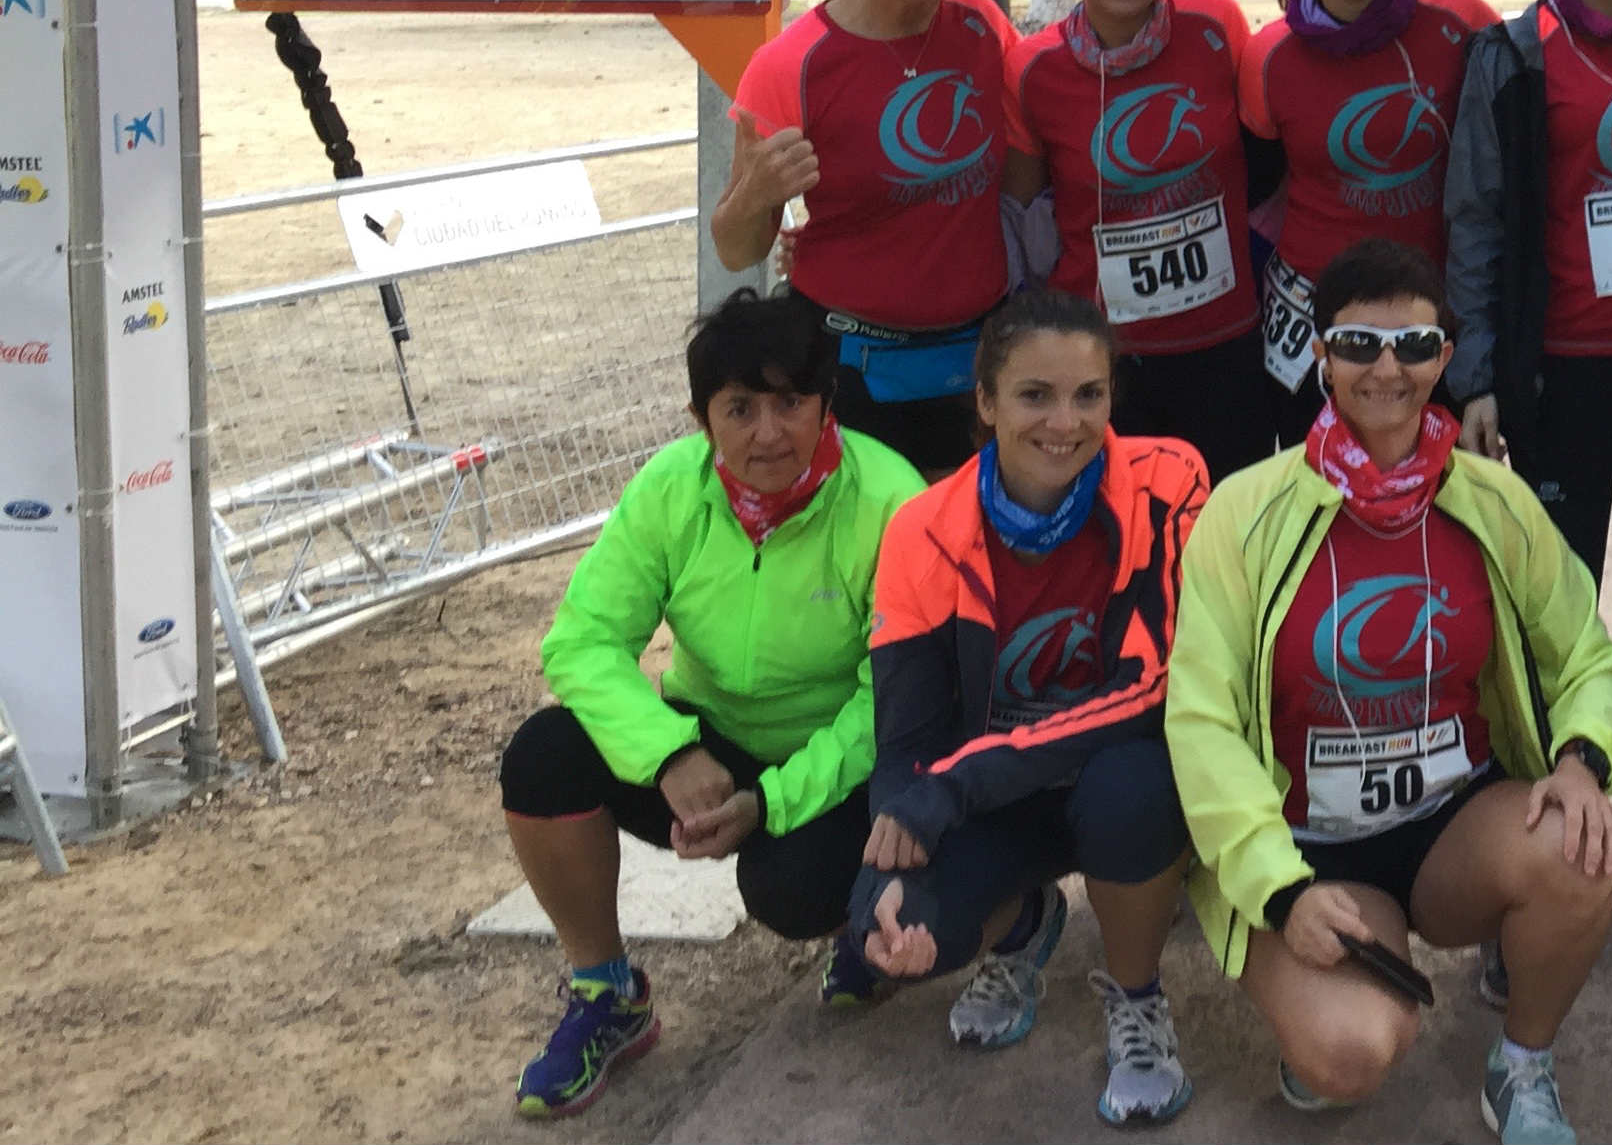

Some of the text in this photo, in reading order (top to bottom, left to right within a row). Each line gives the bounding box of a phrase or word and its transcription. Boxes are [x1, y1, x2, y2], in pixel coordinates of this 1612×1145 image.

[1105, 230, 1160, 247] BREAKFAST
[1129, 241, 1208, 297] 540
[121, 282, 163, 304] AMSTEL
[1361, 764, 1424, 815] 50
